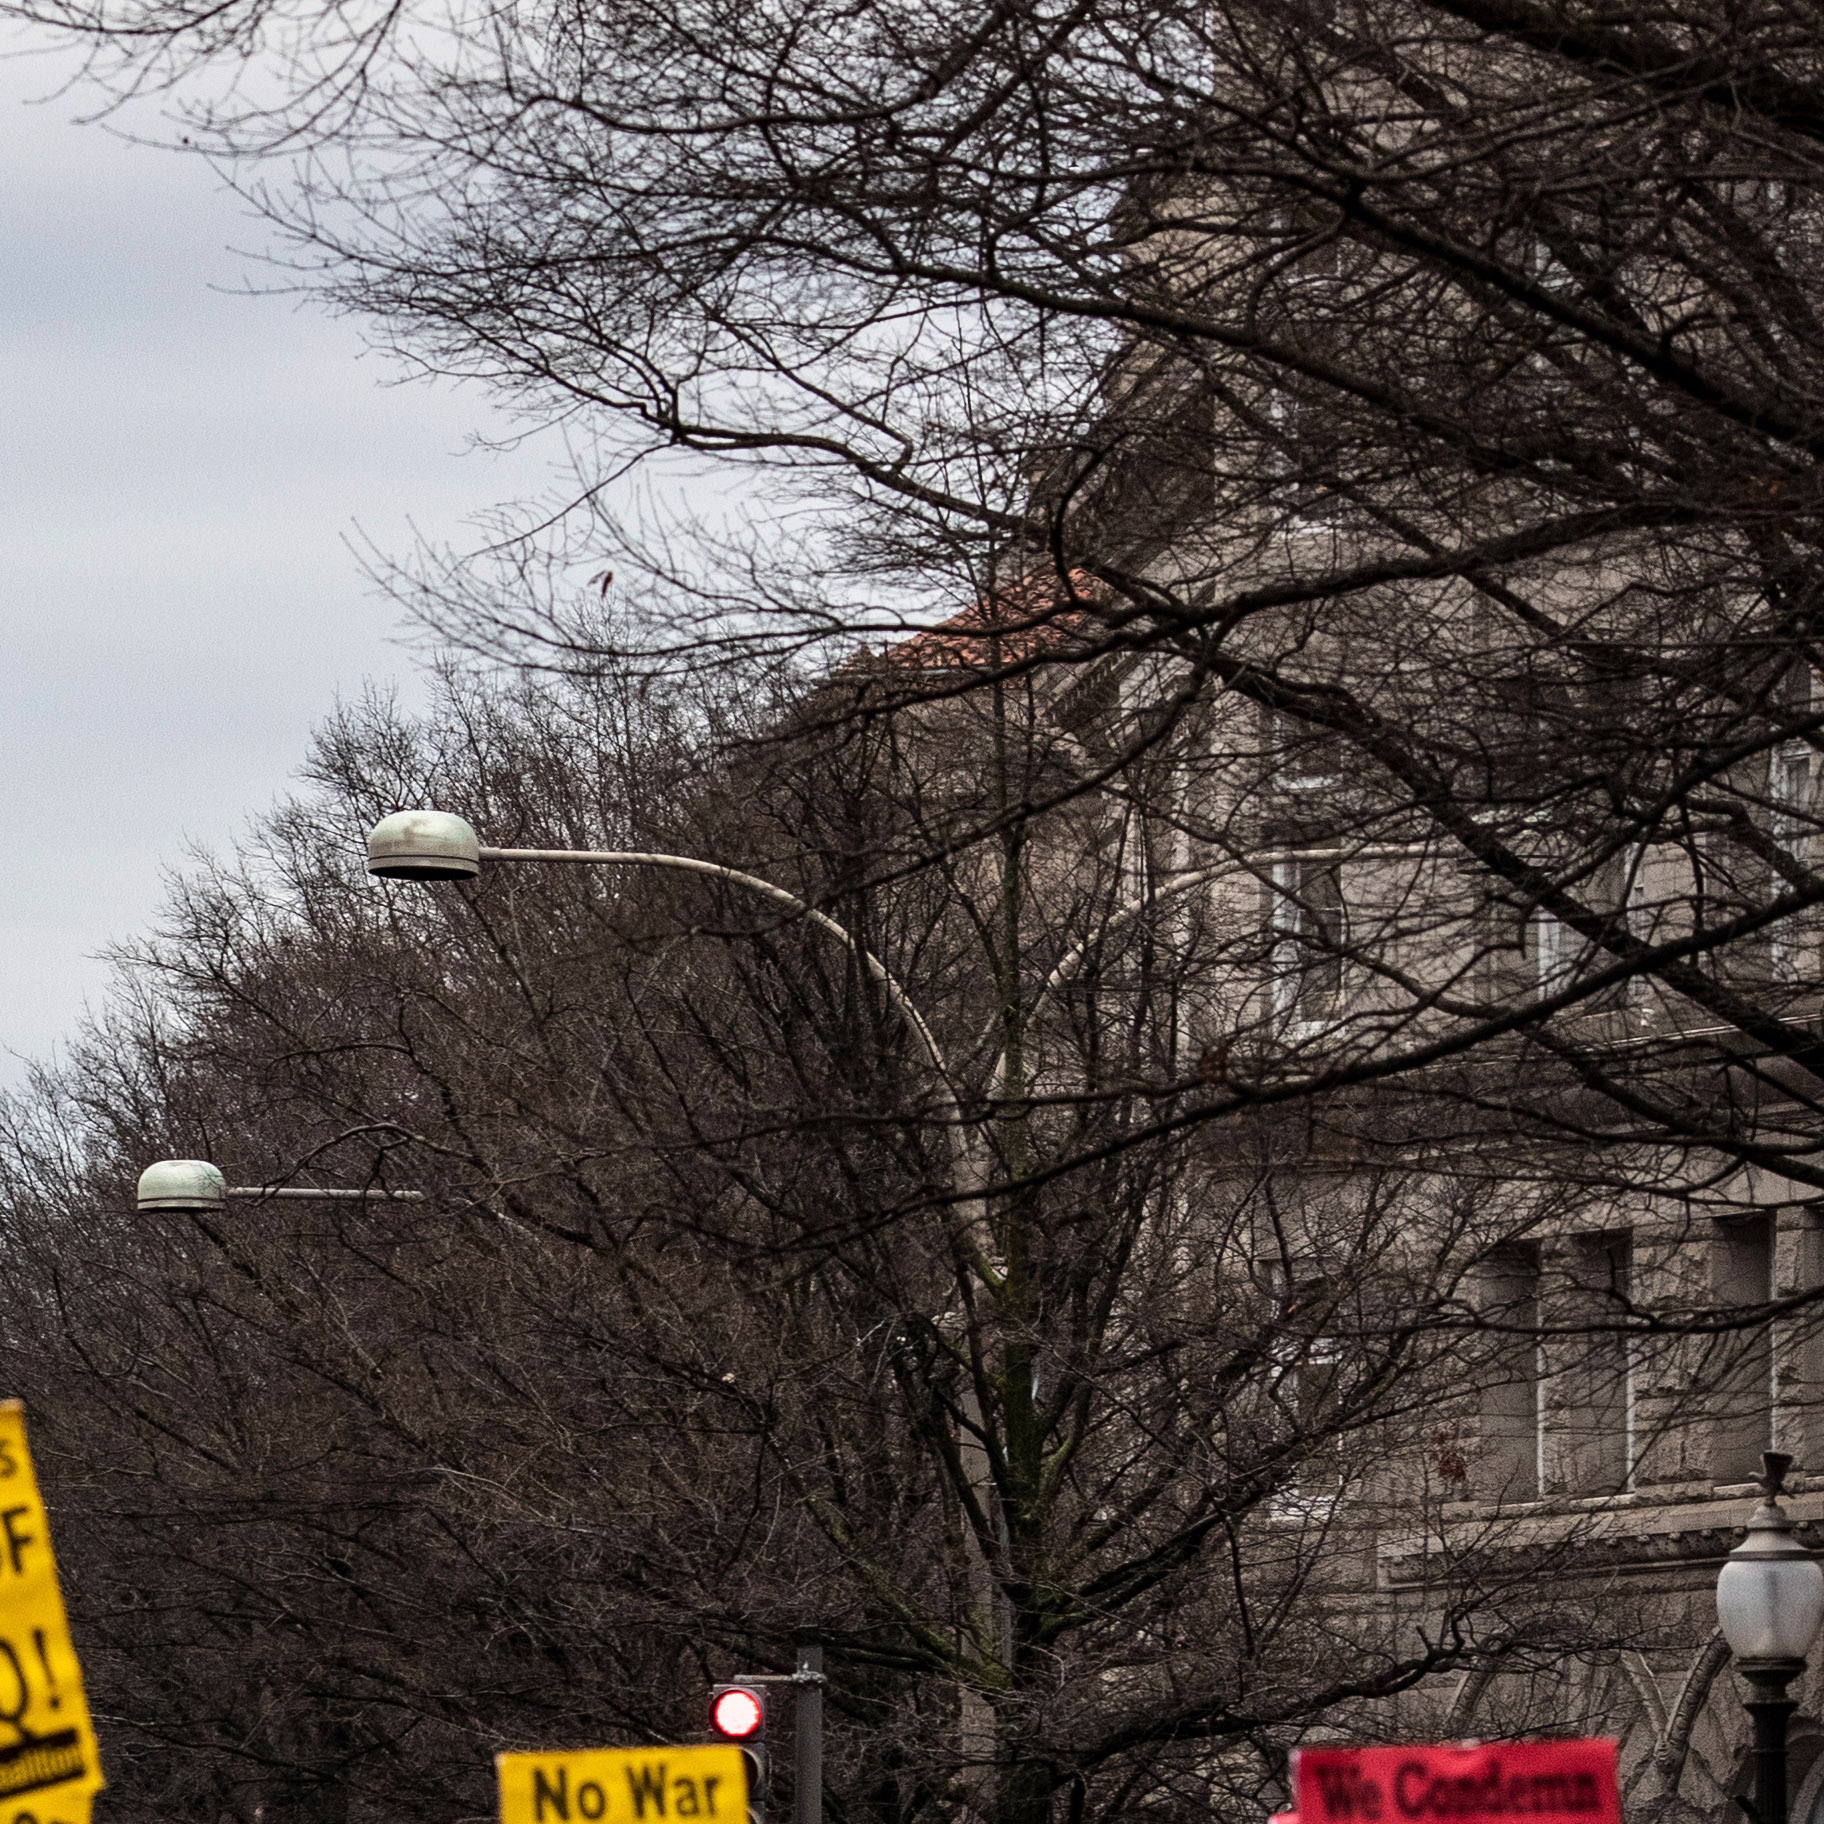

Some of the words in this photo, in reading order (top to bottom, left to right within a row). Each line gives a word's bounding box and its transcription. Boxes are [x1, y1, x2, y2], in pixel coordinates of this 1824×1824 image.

[532, 1766, 606, 1824] No
[624, 1760, 721, 1820] War
[1393, 1757, 1601, 1818] Condemn
